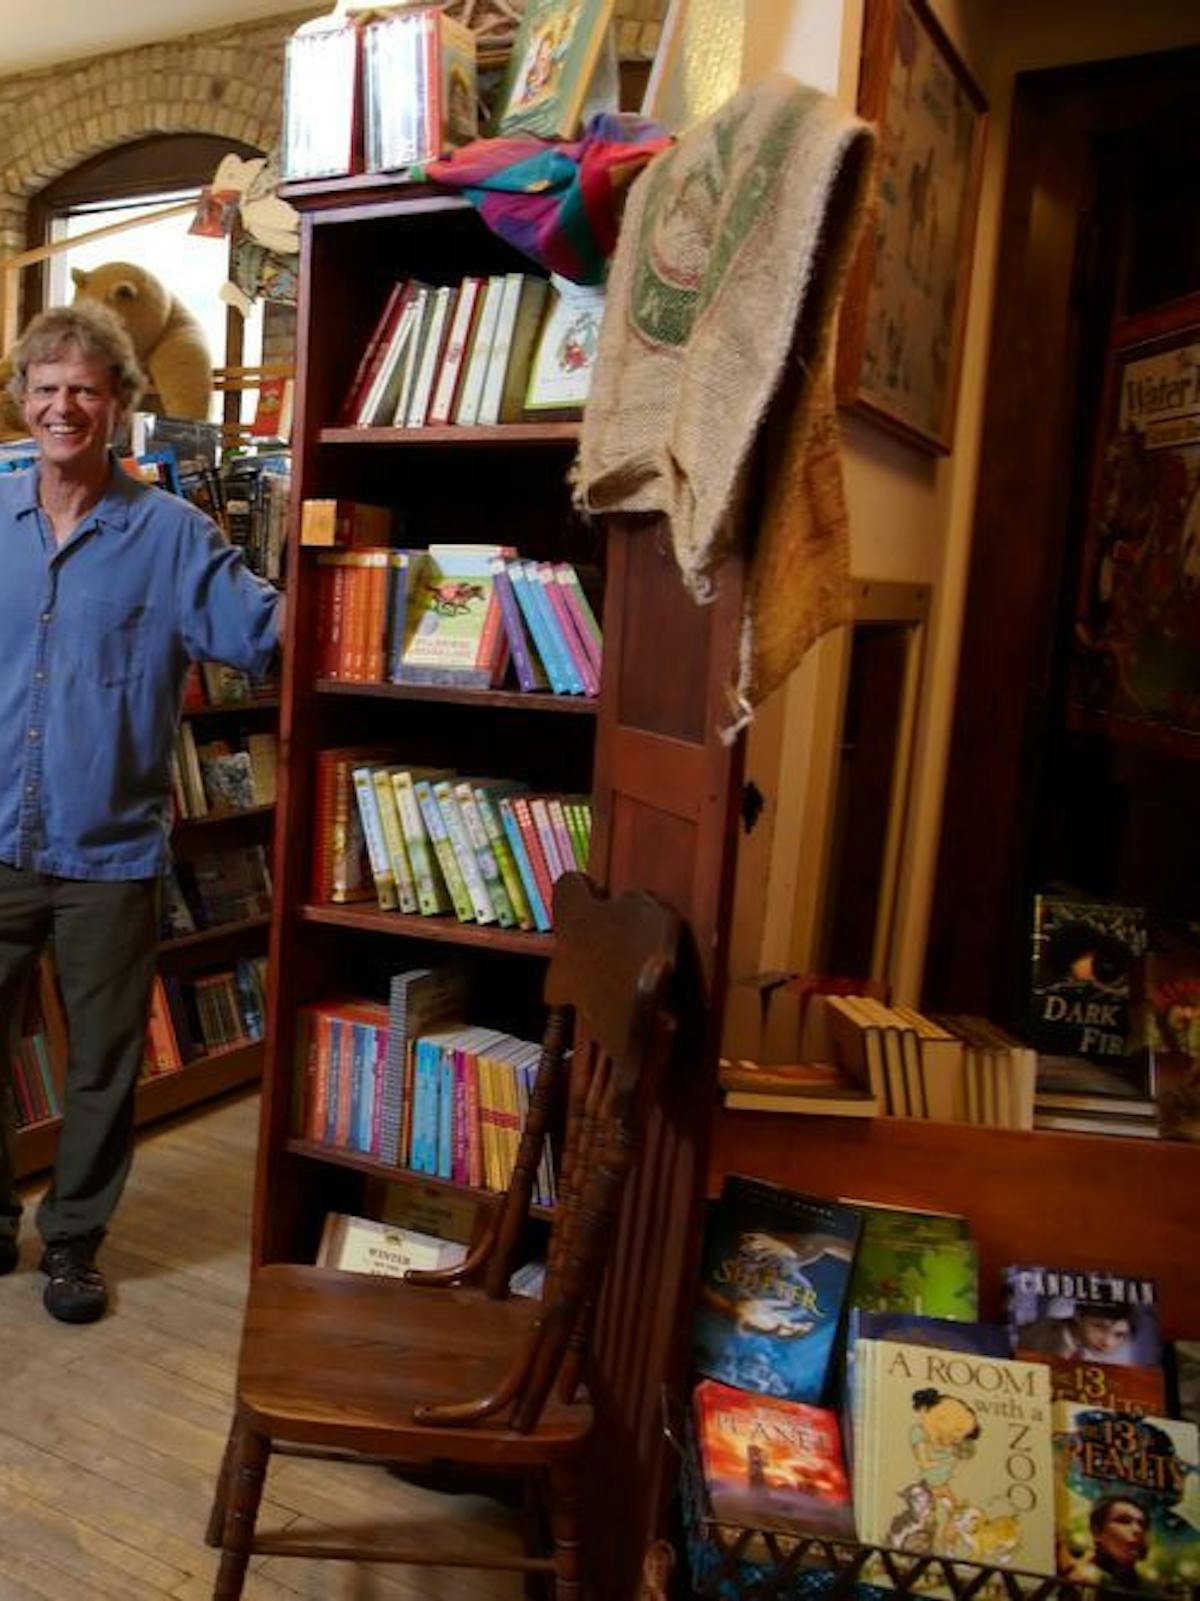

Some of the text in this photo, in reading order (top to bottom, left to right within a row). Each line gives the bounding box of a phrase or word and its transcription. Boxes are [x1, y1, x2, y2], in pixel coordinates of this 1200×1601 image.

[1043, 995, 1121, 1026] DARK
[1019, 1269, 1101, 1301] CANDLE
[888, 1350, 912, 1378] A
[925, 1355, 1036, 1397] ROOM
[974, 1397, 1045, 1422] with a
